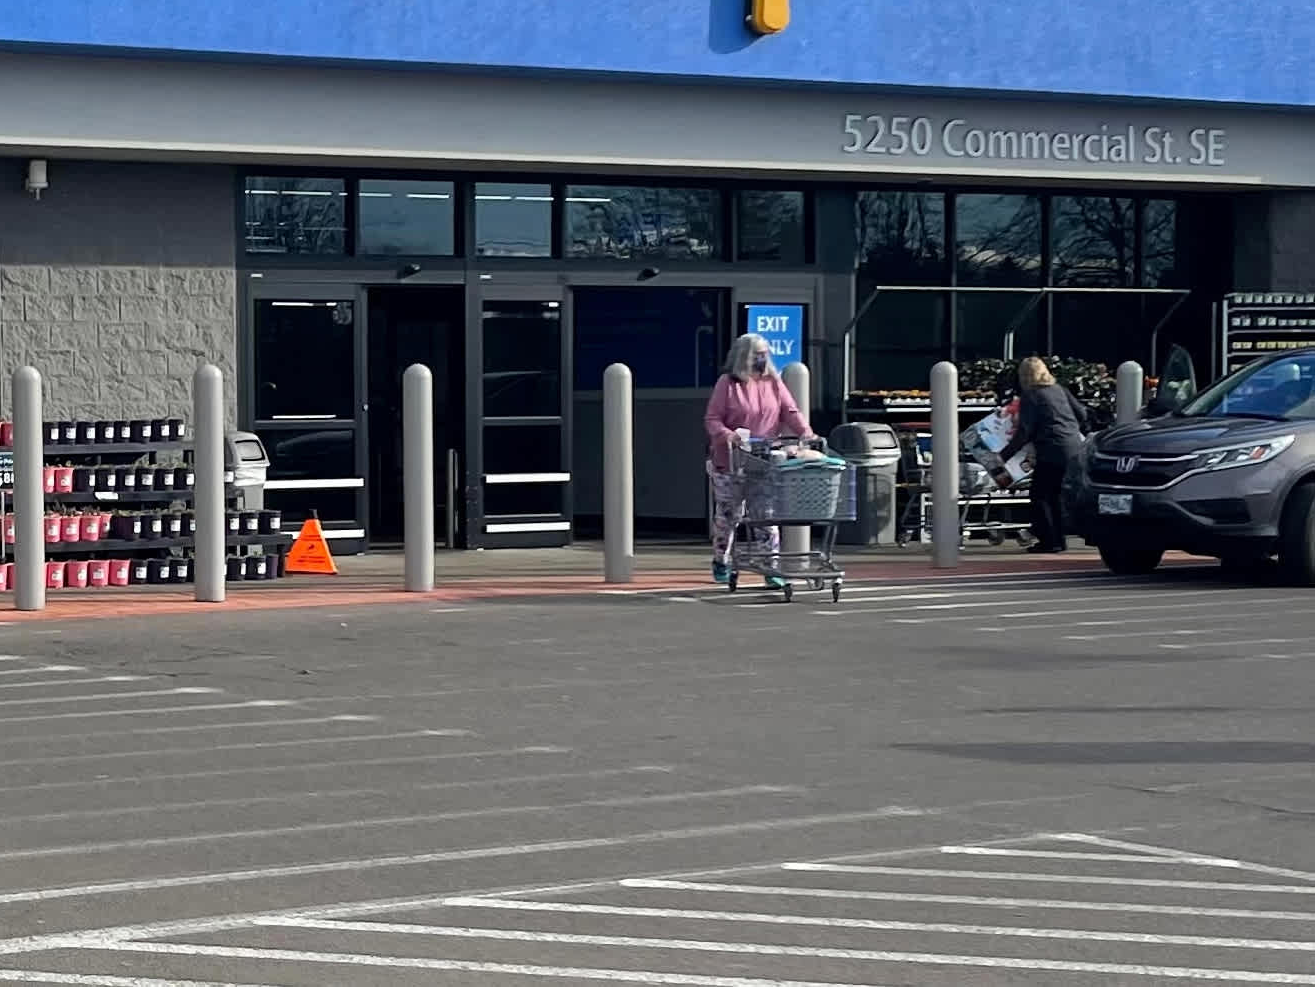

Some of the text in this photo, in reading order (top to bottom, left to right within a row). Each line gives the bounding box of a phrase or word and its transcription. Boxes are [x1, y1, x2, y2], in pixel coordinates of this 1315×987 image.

[841, 114, 1226, 166] 5250 Commercial St. SE
[757, 315, 790, 333] EXIT
[766, 339, 794, 356] NLY
